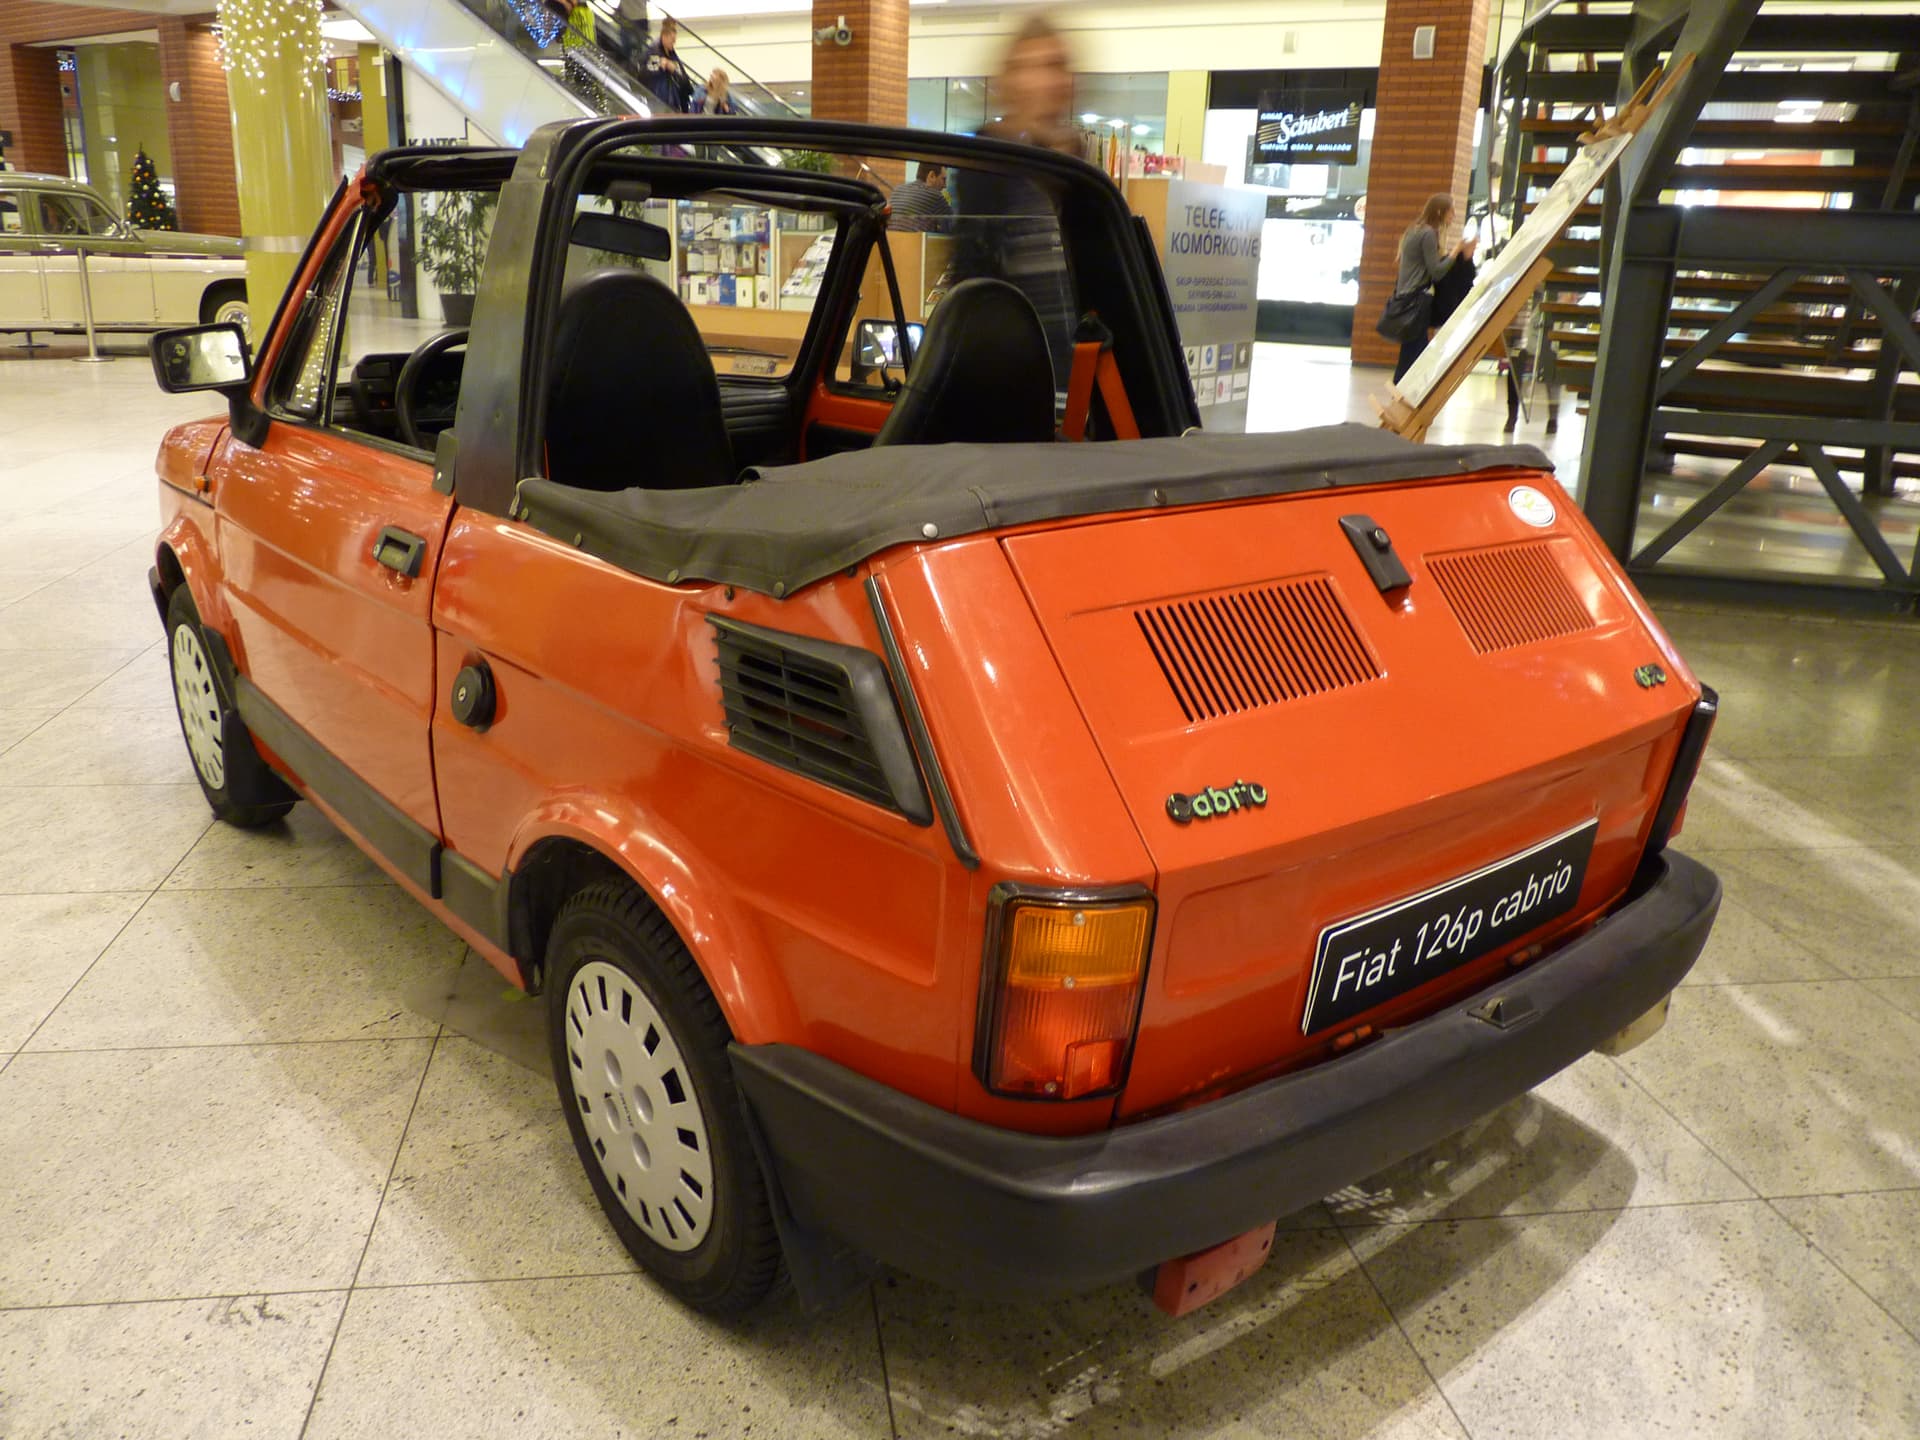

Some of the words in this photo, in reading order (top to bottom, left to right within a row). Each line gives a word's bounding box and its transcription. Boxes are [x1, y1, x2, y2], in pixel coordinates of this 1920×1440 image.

[1277, 108, 1349, 144] Schubert
[1171, 230, 1259, 258] KOMÓRKOWE
[1332, 937, 1402, 1002] Fiat
[1413, 904, 1484, 966] 126p
[1490, 859, 1573, 929] cabrio
